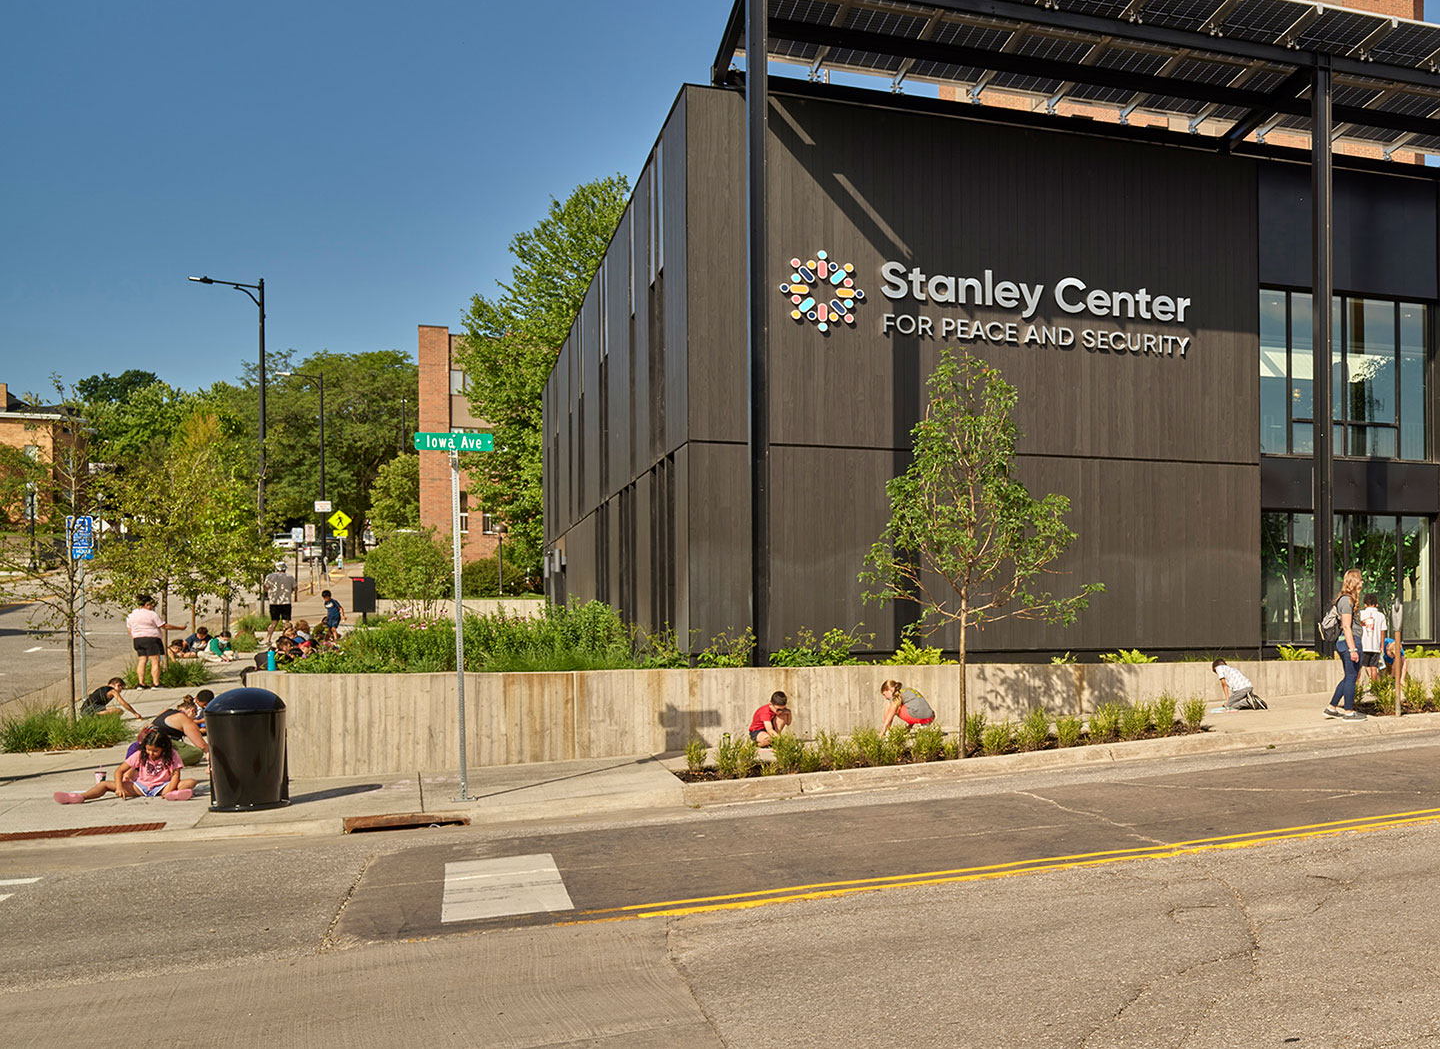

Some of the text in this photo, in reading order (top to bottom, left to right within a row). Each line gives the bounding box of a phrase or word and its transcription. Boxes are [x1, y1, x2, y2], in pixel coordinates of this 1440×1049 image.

[881, 261, 1191, 322] Stanley Center
[882, 313, 1190, 355] FOR PEACE AND SECURITY
[426, 434, 482, 449] Iowa Ave
